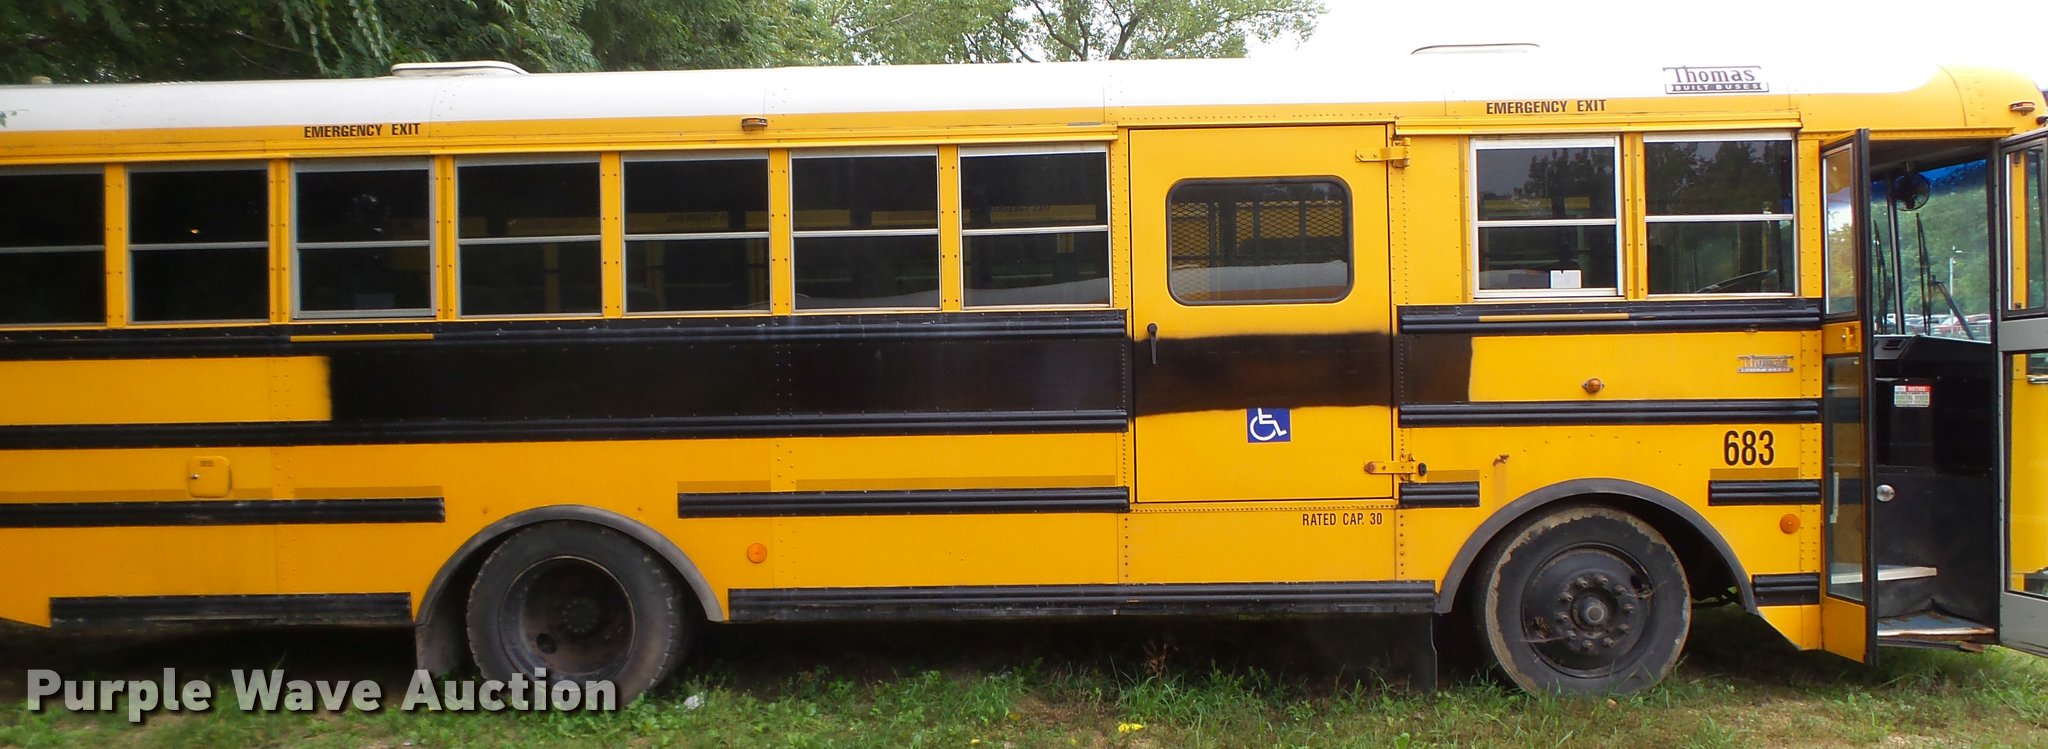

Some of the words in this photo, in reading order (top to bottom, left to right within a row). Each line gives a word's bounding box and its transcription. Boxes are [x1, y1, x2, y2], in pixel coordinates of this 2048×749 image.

[1663, 65, 1758, 82] Thomas
[1486, 100, 1567, 114] EMERGENCY
[1577, 99, 1606, 112] EXIT
[304, 124, 382, 138] EMERGENCY
[391, 122, 420, 136] EXIT
[1724, 430, 1774, 466] 683
[1302, 513, 1336, 526] RATED
[1342, 512, 1364, 526] CAP.
[1370, 512, 1383, 525] 30
